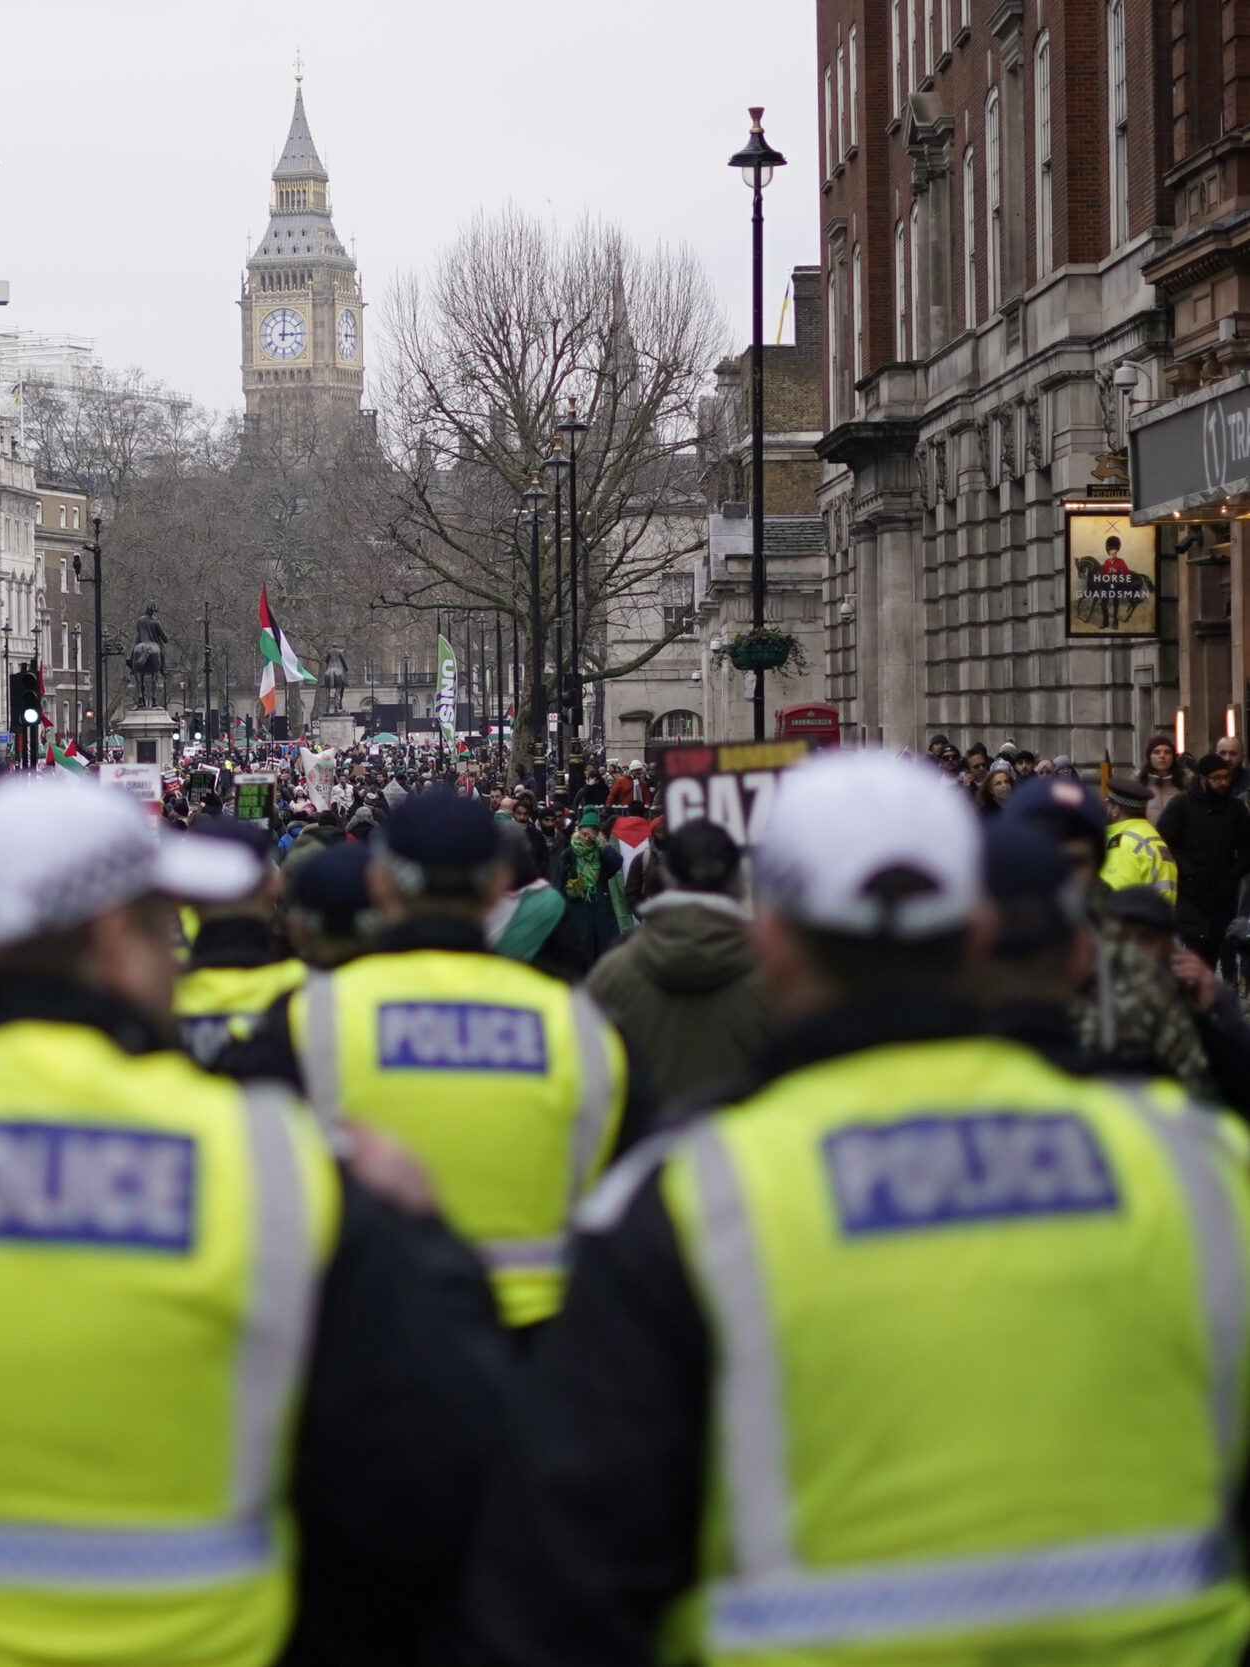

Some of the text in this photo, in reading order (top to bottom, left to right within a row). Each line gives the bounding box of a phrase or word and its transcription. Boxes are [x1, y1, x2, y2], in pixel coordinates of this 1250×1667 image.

[1075, 590, 1150, 599] GUARDSMAN
[1093, 574, 1132, 583] HORSE
[382, 1006, 543, 1066] POLICE
[831, 1113, 1107, 1220] POLICE
